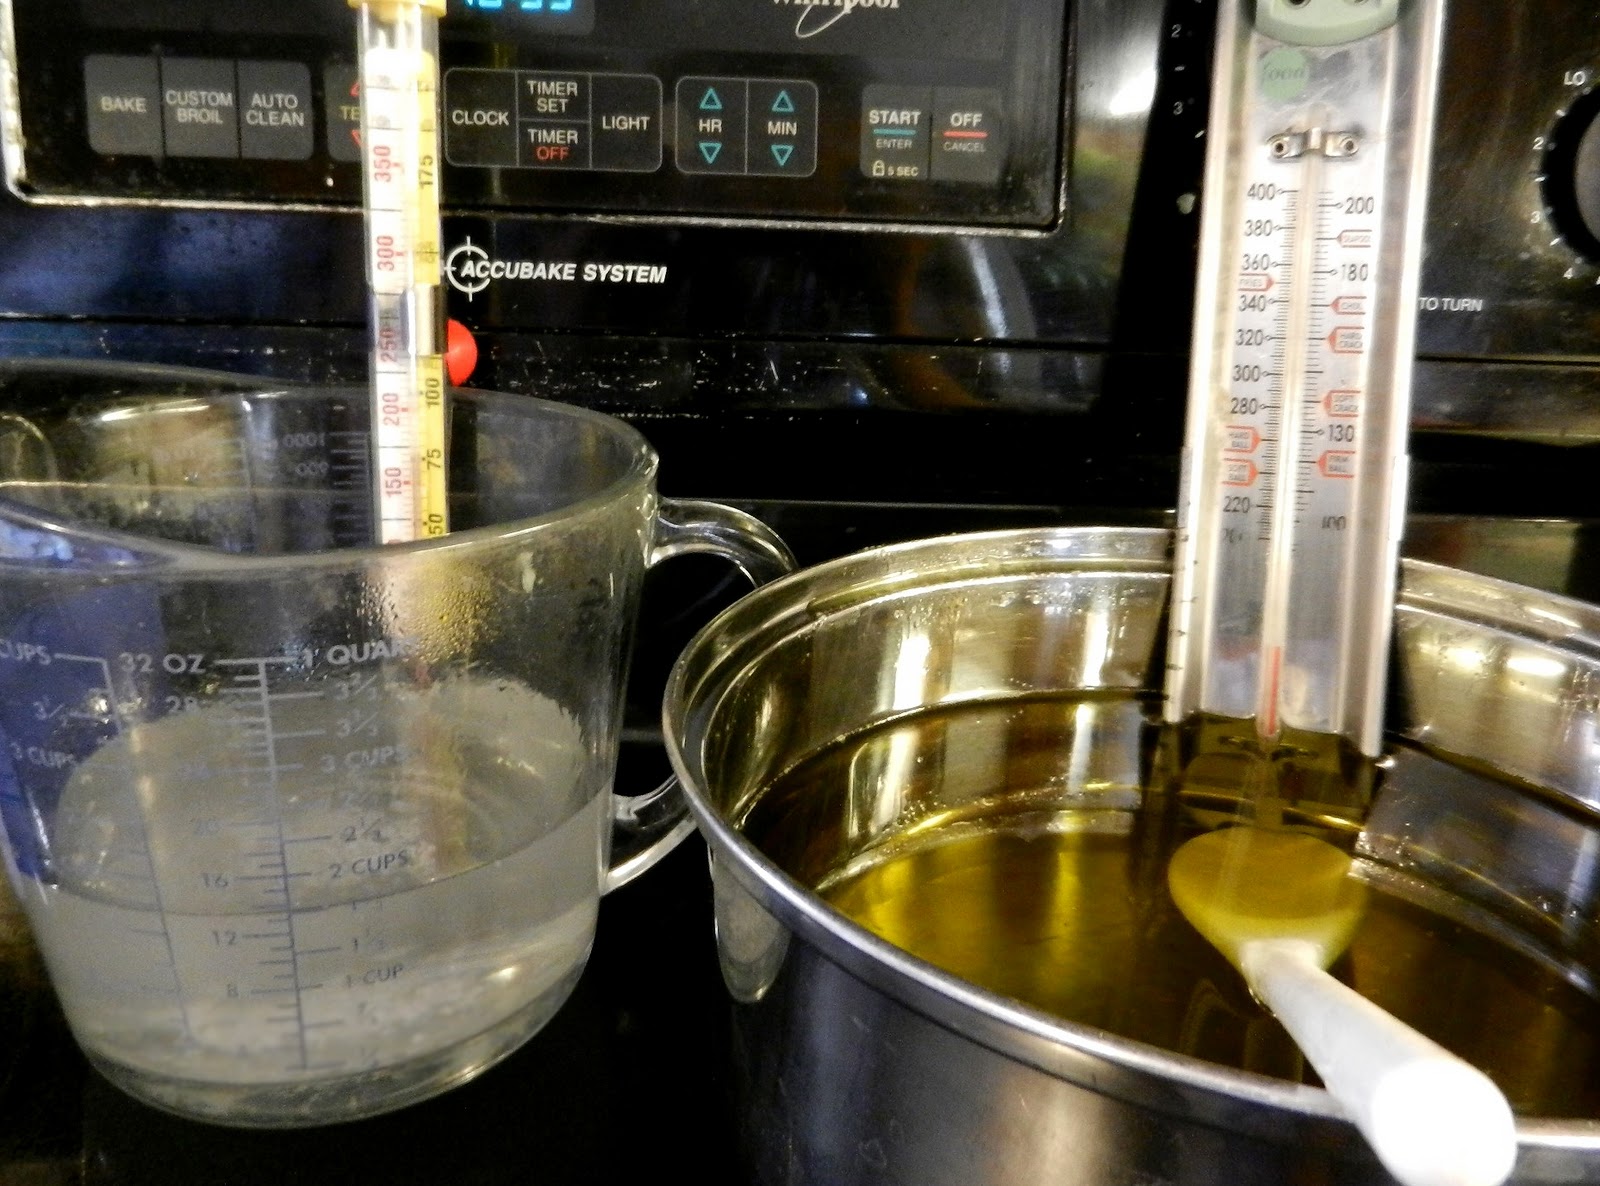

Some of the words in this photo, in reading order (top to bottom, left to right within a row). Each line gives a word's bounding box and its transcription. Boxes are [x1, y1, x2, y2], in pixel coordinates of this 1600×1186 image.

[1171, 24, 1182, 38] 2
[1564, 71, 1586, 86] LO
[527, 80, 578, 96] TIMER
[101, 96, 146, 113] BAKE
[165, 89, 233, 107] CUSTOM
[251, 93, 298, 109] AUTO
[536, 98, 568, 113] SET
[177, 108, 223, 125] BROIL
[1173, 101, 1183, 115] 3
[246, 109, 304, 126] CLEAN
[452, 110, 509, 126] CLOCK
[602, 116, 650, 130] LIGHT
[869, 109, 921, 125] START
[950, 112, 983, 127] OFF
[699, 119, 722, 133] HR
[768, 121, 797, 136] MIN
[528, 129, 578, 144] TIMER
[876, 138, 912, 149] ENTER
[1533, 137, 1544, 149] 2
[536, 146, 569, 161] OFF
[943, 141, 986, 153] CANCEL
[374, 145, 392, 183] 350
[418, 155, 434, 189] 175
[897, 166, 919, 177] SEC
[1247, 183, 1276, 201] 400
[1345, 196, 1375, 214] 200
[1530, 211, 1540, 224] 3
[1244, 219, 1273, 237] 380
[376, 235, 394, 272] 300
[1242, 253, 1270, 271] 360
[460, 260, 577, 281] ACCUBAKE
[583, 263, 667, 283] SYSTEM
[1341, 263, 1369, 281] 180
[1238, 294, 1267, 312] 340
[1441, 297, 1483, 312] TURN
[379, 327, 397, 363] 250
[1235, 329, 1264, 346] 320
[1232, 364, 1261, 382] 300
[425, 378, 440, 408] 100
[383, 392, 399, 426] 200
[1230, 397, 1258, 415] 280
[1328, 424, 1355, 442] 130
[427, 448, 442, 470] 75
[385, 466, 402, 498] 150
[1223, 496, 1250, 513] 220
[428, 512, 444, 535] 50
[120, 651, 154, 674] 32
[162, 653, 206, 674] OZ
[352, 849, 410, 874] CUPS
[202, 871, 228, 888] 16
[212, 929, 237, 946] 12
[362, 963, 405, 985] CUP
